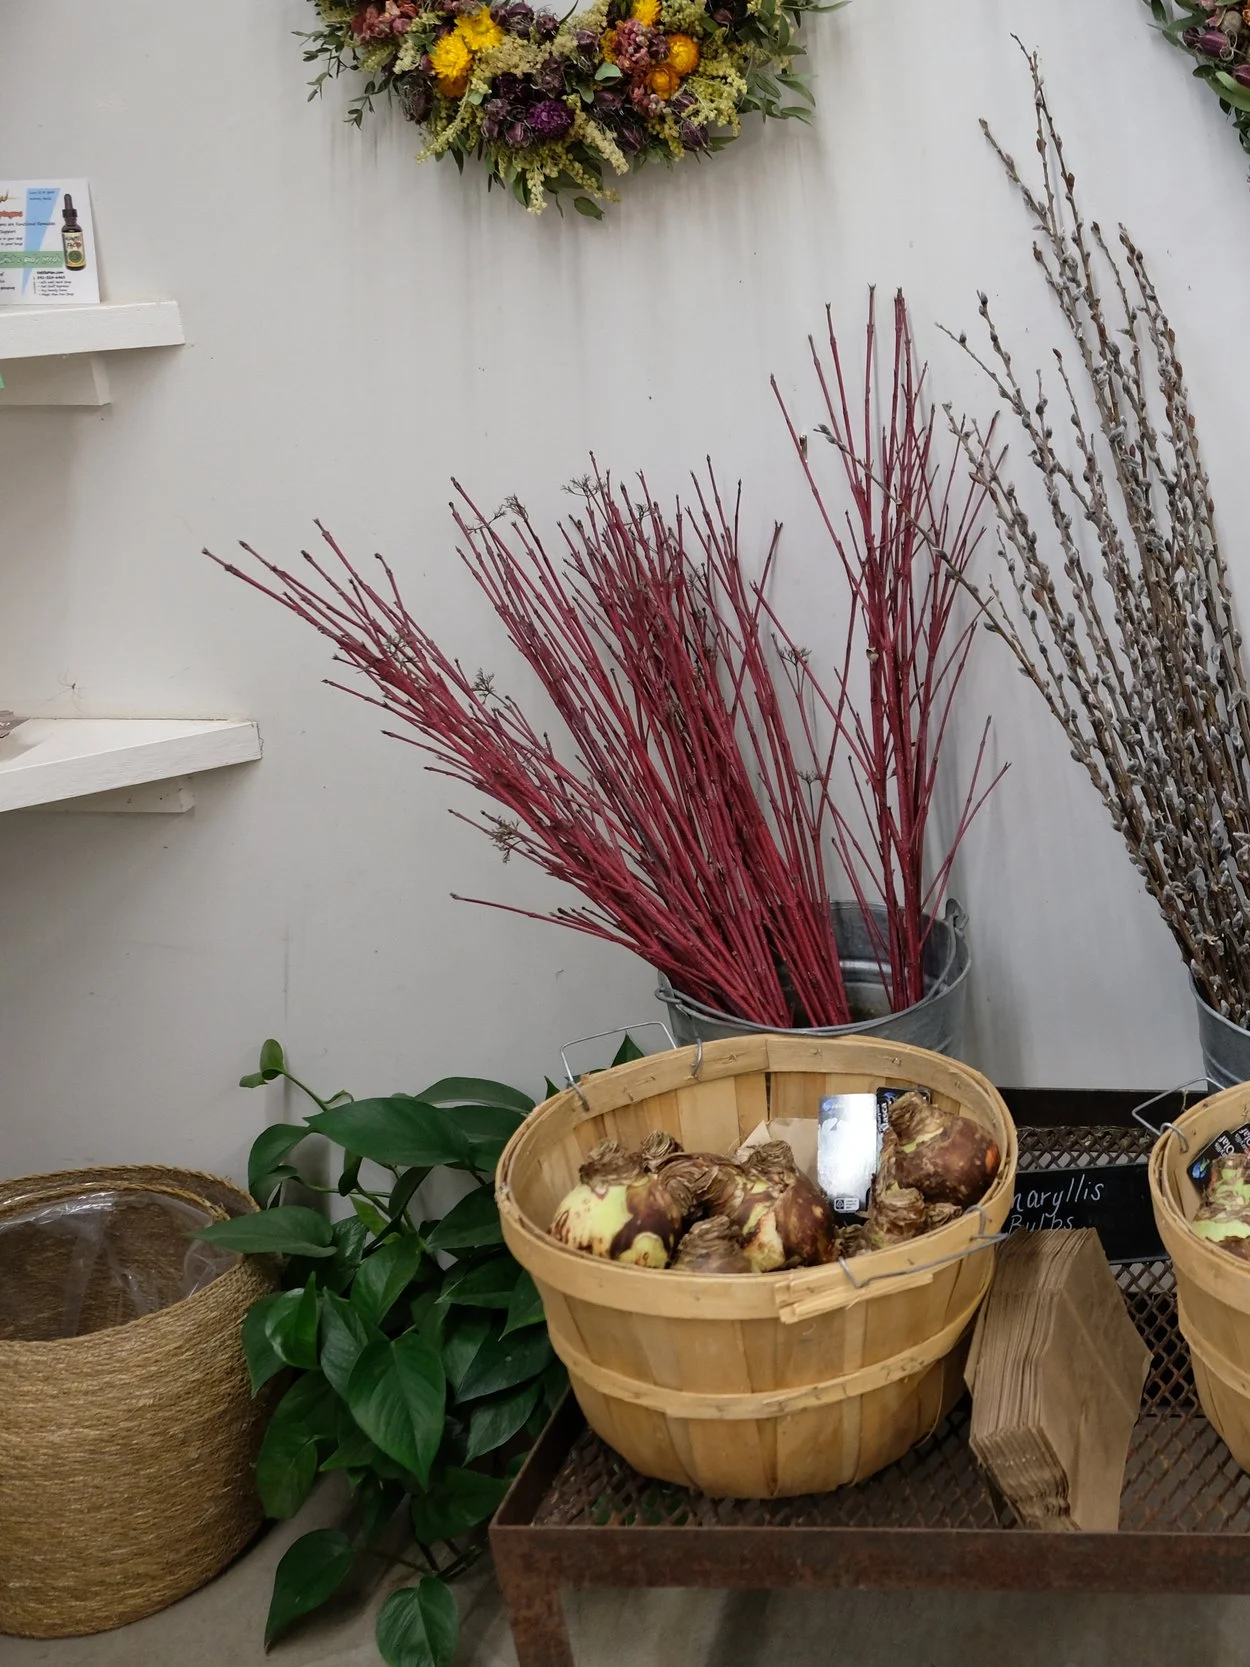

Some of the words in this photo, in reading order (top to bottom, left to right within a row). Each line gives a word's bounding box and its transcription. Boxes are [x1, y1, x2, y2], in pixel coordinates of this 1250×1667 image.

[1218, 1135, 1235, 1154] Olaf
[1012, 1173, 1104, 1217] maryllis
[1009, 1213, 1074, 1235] Bulbs
